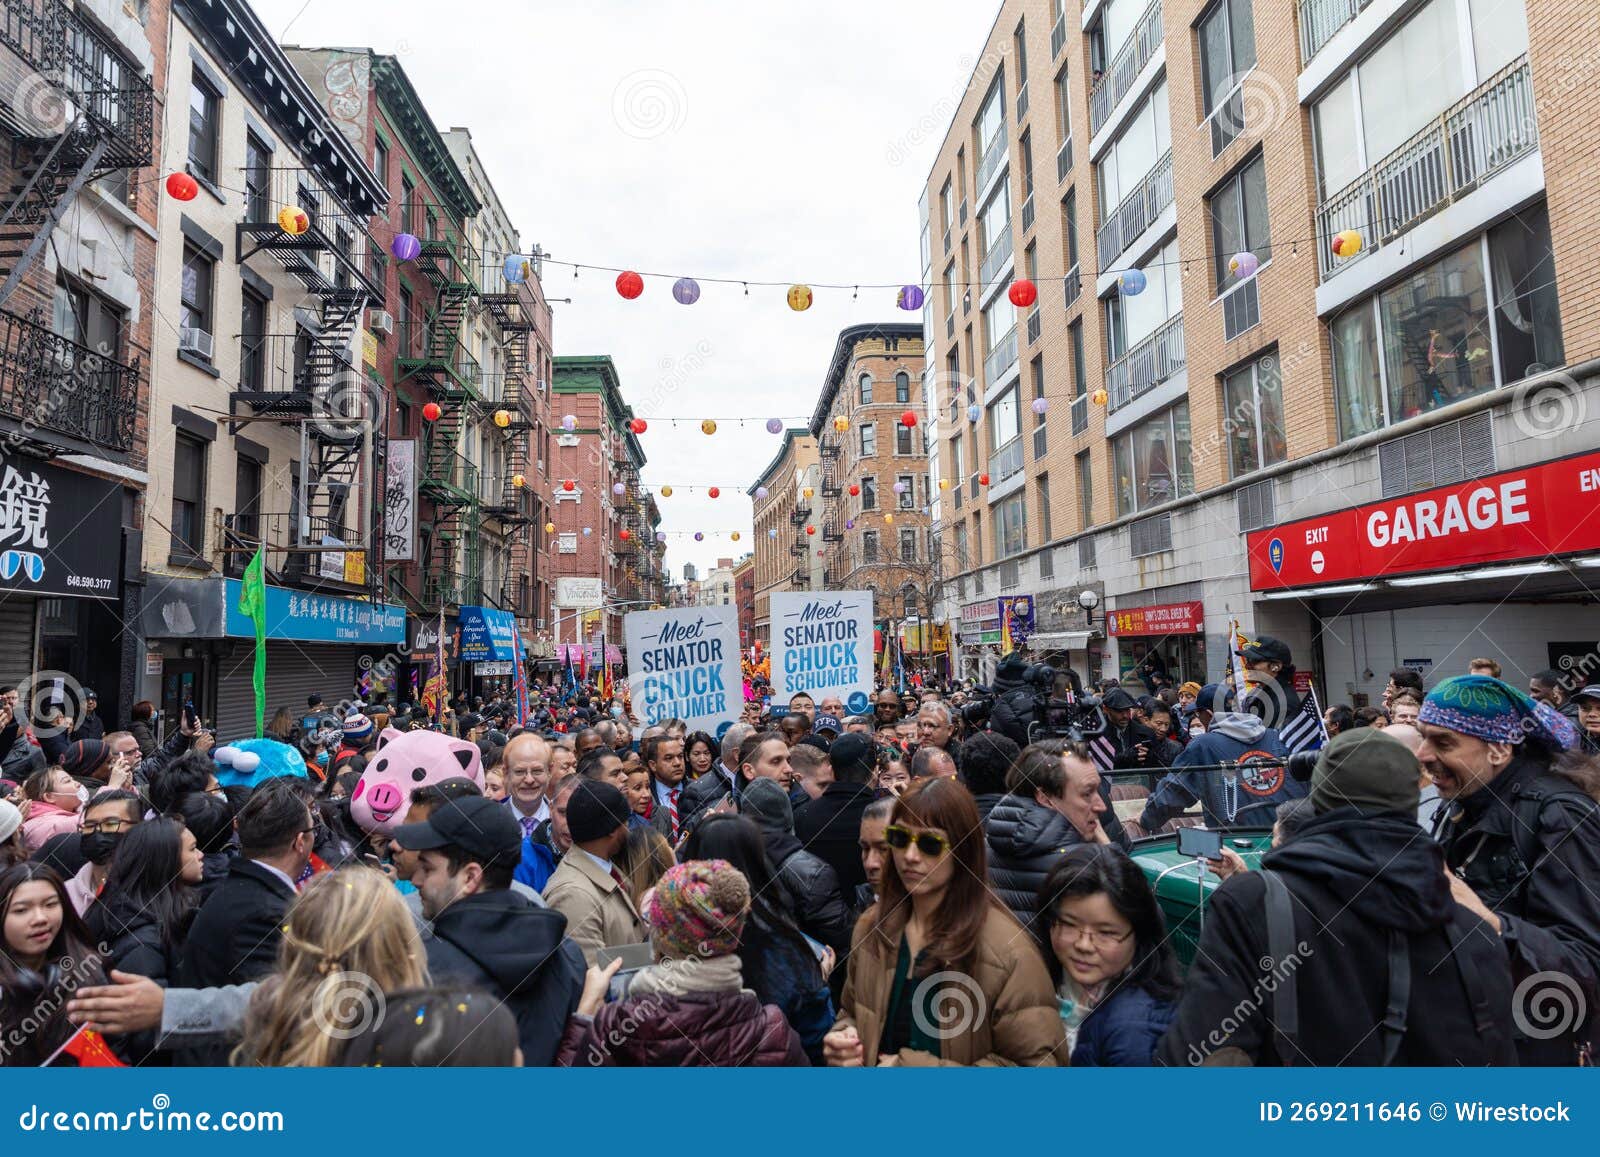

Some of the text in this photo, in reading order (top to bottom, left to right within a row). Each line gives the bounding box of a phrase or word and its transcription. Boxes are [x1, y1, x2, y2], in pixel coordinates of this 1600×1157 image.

[0, 464, 51, 549] 鏡
[1367, 479, 1531, 548] GARAGE
[1306, 526, 1329, 545] EXIT
[66, 574, 111, 590] 646.590.3177
[384, 609, 404, 633] Grocery
[800, 600, 842, 622] Meet
[658, 616, 704, 644] Meet
[784, 619, 858, 647] SENATOR
[642, 638, 723, 673] SENATOR
[784, 641, 858, 674] CHUCK
[644, 663, 725, 704] CHUCK
[785, 666, 858, 692] SCHUMER
[647, 692, 727, 725] SCHUMER
[815, 716, 837, 729] NYPD
